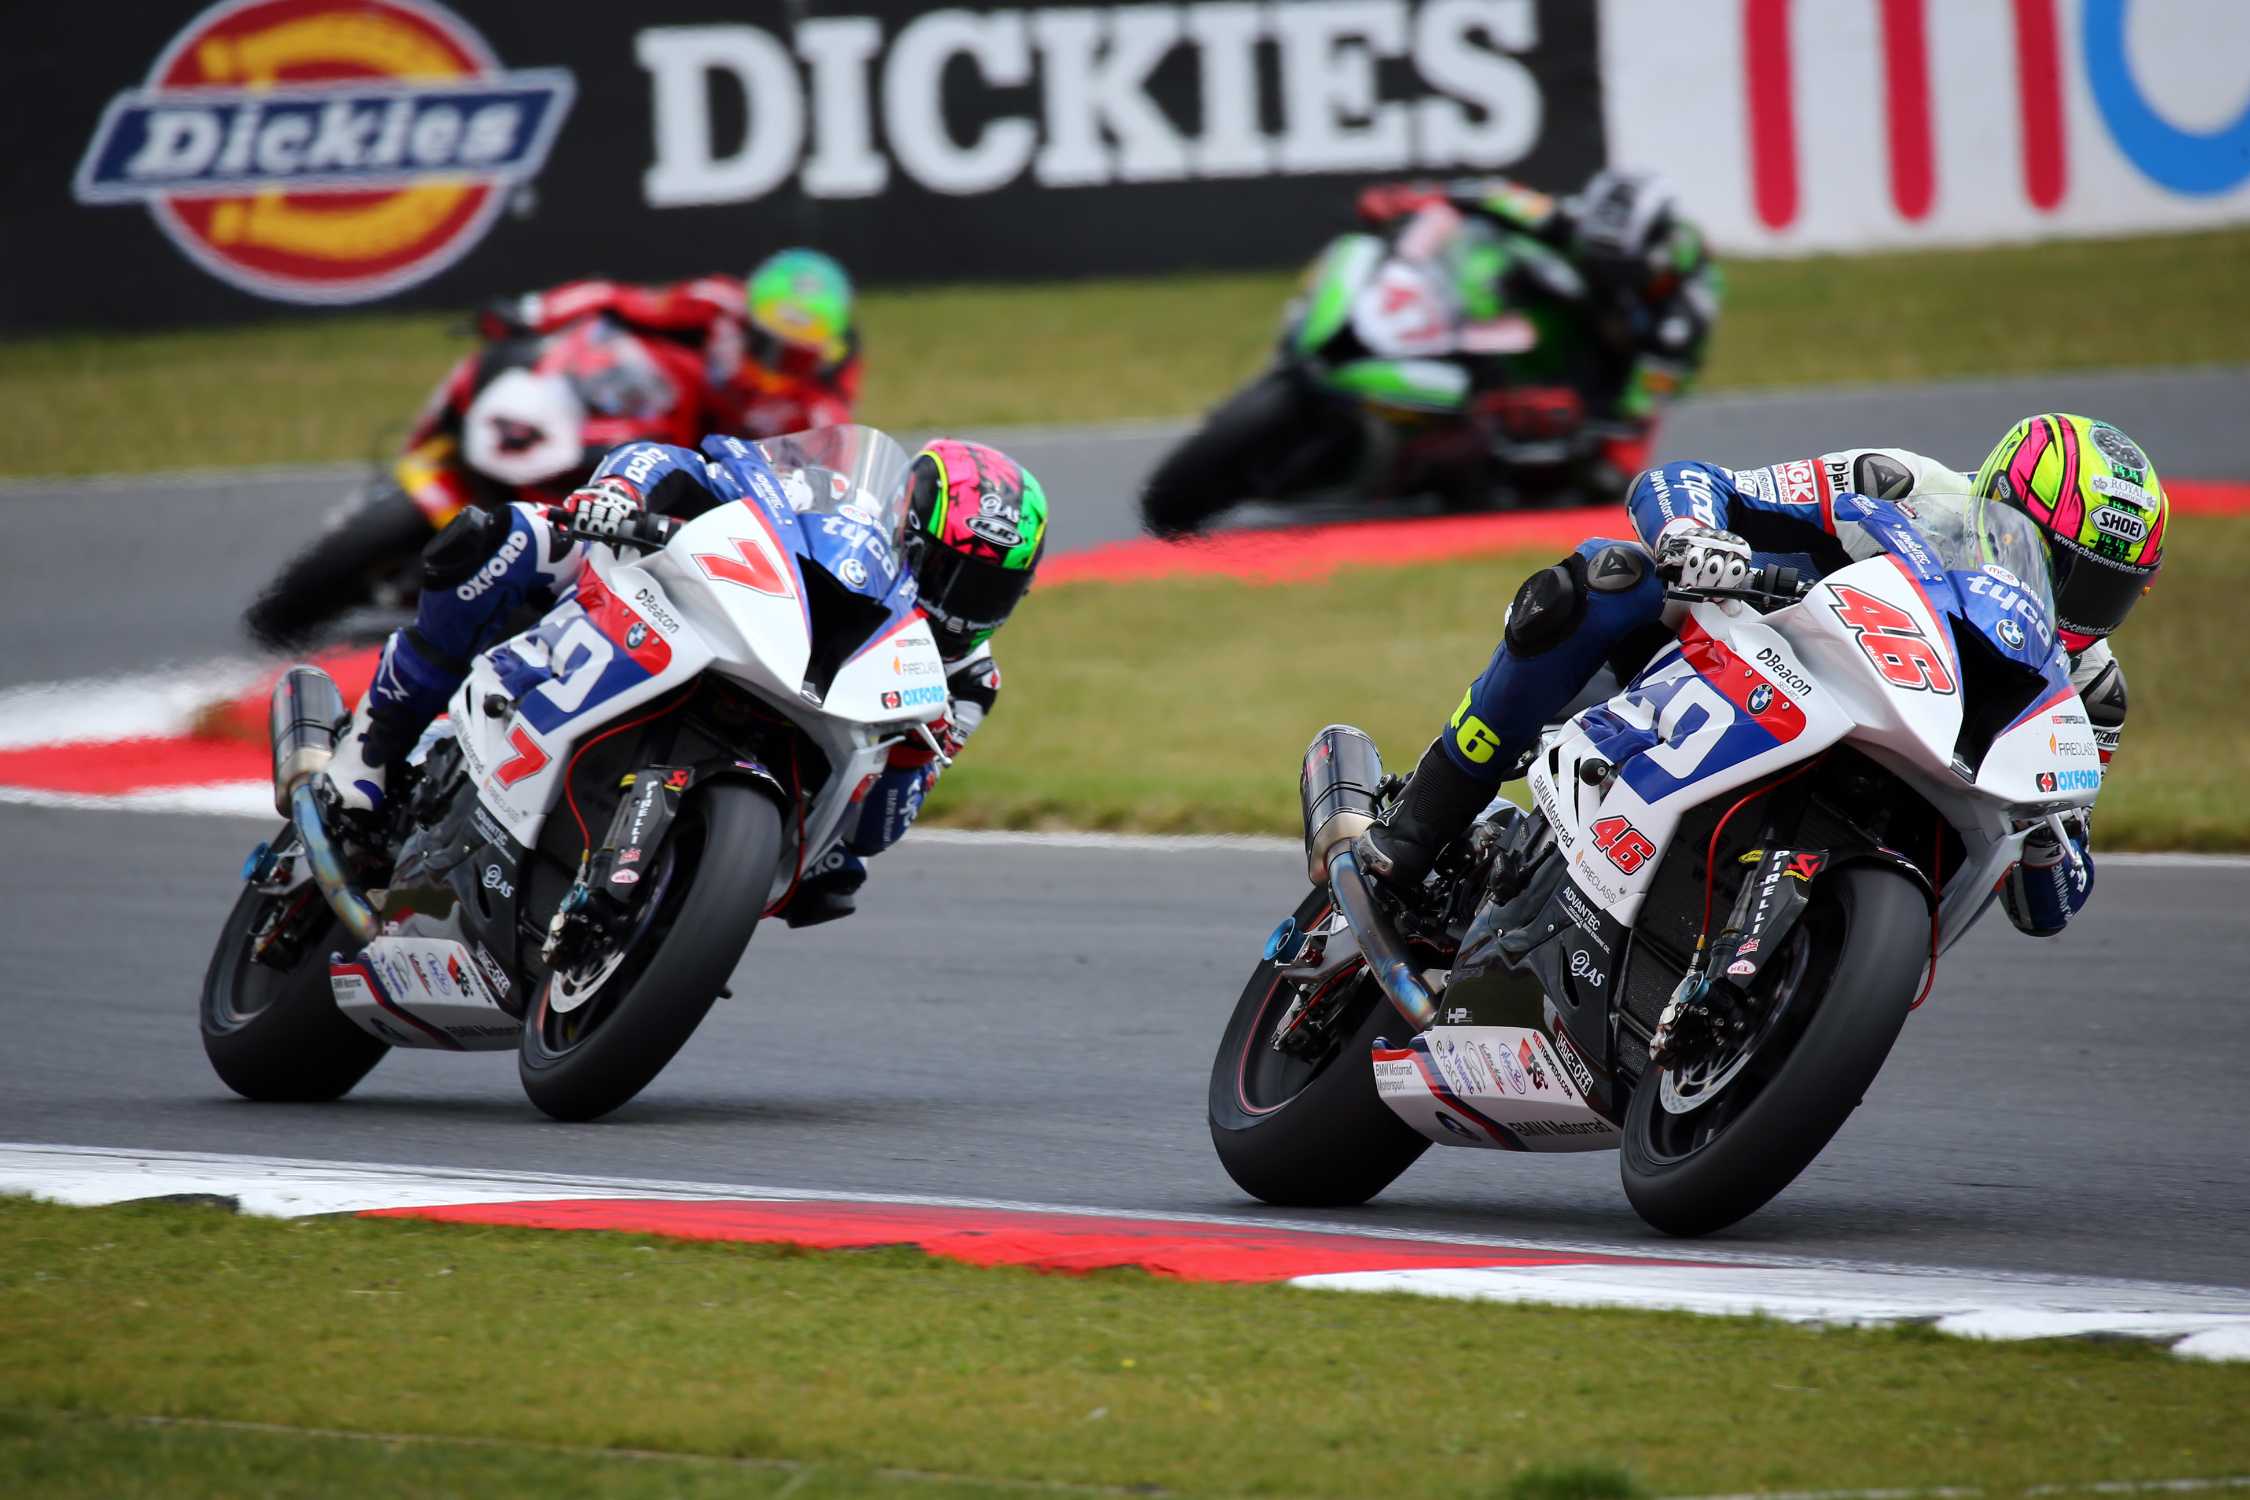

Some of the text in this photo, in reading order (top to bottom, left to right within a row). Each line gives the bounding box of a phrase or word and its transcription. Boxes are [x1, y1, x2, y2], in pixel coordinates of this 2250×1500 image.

[636, 0, 1543, 206] DICKIES
[124, 98, 522, 178] Dickies
[2110, 477, 2145, 499] ROYAL
[821, 515, 898, 581] tyco
[2100, 511, 2142, 538] SHOEI
[457, 531, 528, 601] OXFORD
[691, 537, 796, 598] 7
[1824, 583, 1956, 695] 46
[1967, 575, 2051, 647] tyco
[492, 723, 552, 791] 7
[2058, 770, 2099, 790] OXFORD
[1533, 774, 1576, 849] BMW Motorrad
[1590, 815, 1656, 875] 46
[1563, 886, 1601, 932] ADVANTEC
[1579, 860, 1617, 904] FIRECLASS
[1752, 850, 1791, 935] PIRELLI
[1532, 1030, 1573, 1100] REDTORPEDO.COM
